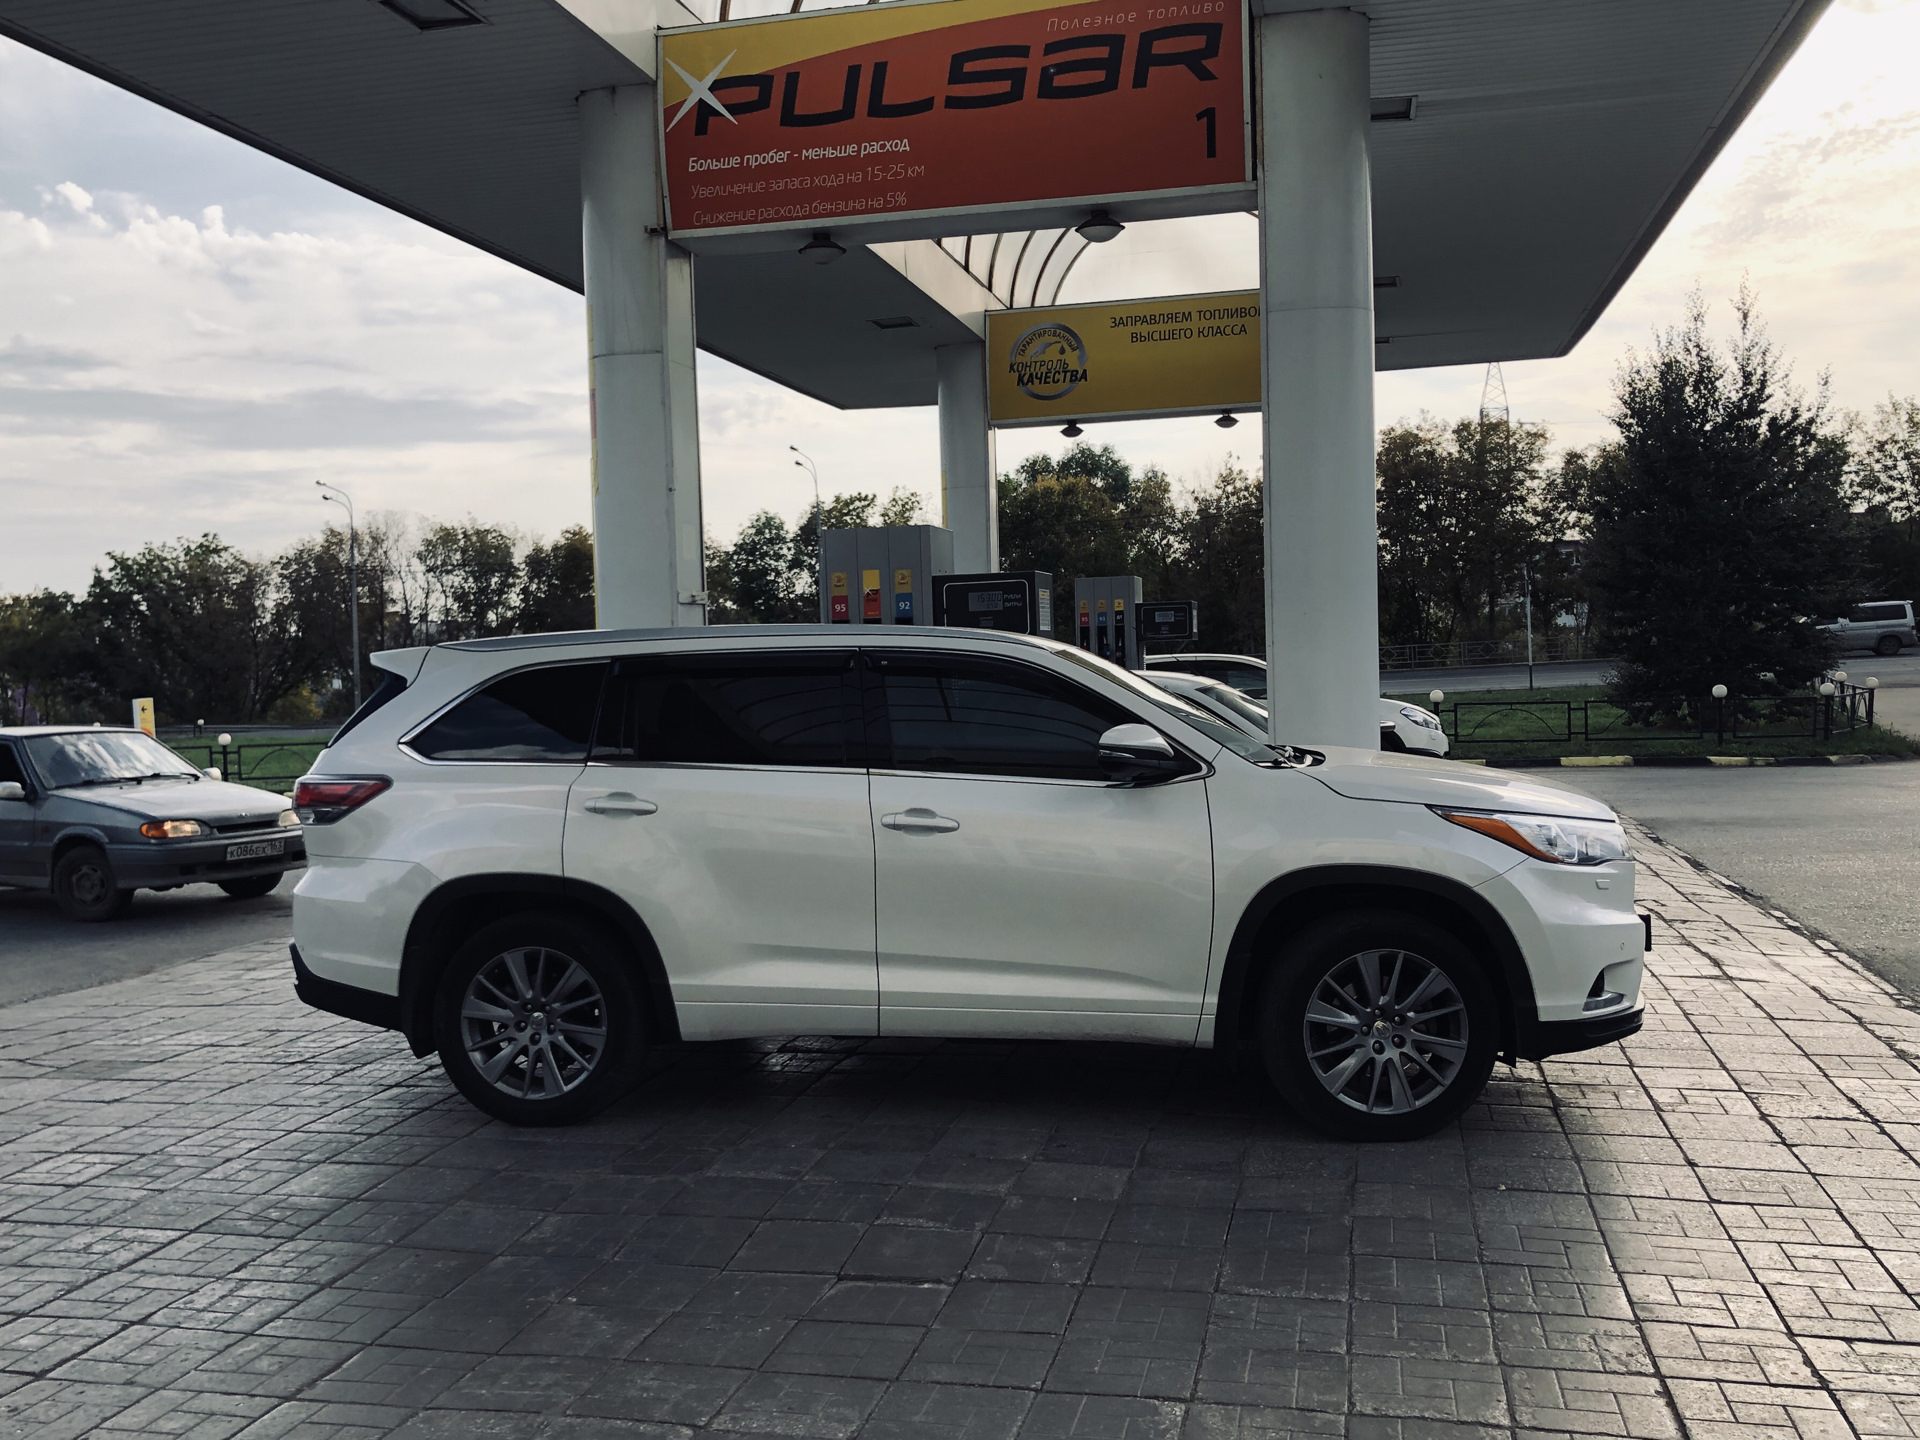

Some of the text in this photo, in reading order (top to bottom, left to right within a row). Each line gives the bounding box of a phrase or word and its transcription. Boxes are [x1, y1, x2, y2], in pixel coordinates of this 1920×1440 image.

[1047, 1, 1225, 32] Полезное топливо
[1195, 106, 1217, 159] 1
[688, 156, 741, 172] Больше
[743, 148, 791, 169] пробег
[802, 143, 858, 160] меньше
[860, 138, 910, 158] расход
[691, 163, 925, 199] Увеличение запаса хода на 15-25 км
[693, 191, 907, 226] Снижение расхода бензина на 5%
[1110, 305, 1260, 329] ЗАПРАВЛЯЕМ ТОПЛИВО
[1018, 329, 1079, 357] ГАРАНТИРОВАННЫЙ
[1130, 323, 1248, 343] ВЫСШЕГО КЛАССА
[1008, 358, 1070, 374] КОНТРОЛЬ
[1017, 368, 1088, 387] КАЧЕСТВА
[834, 603, 846, 613] 95
[898, 601, 910, 610] 92
